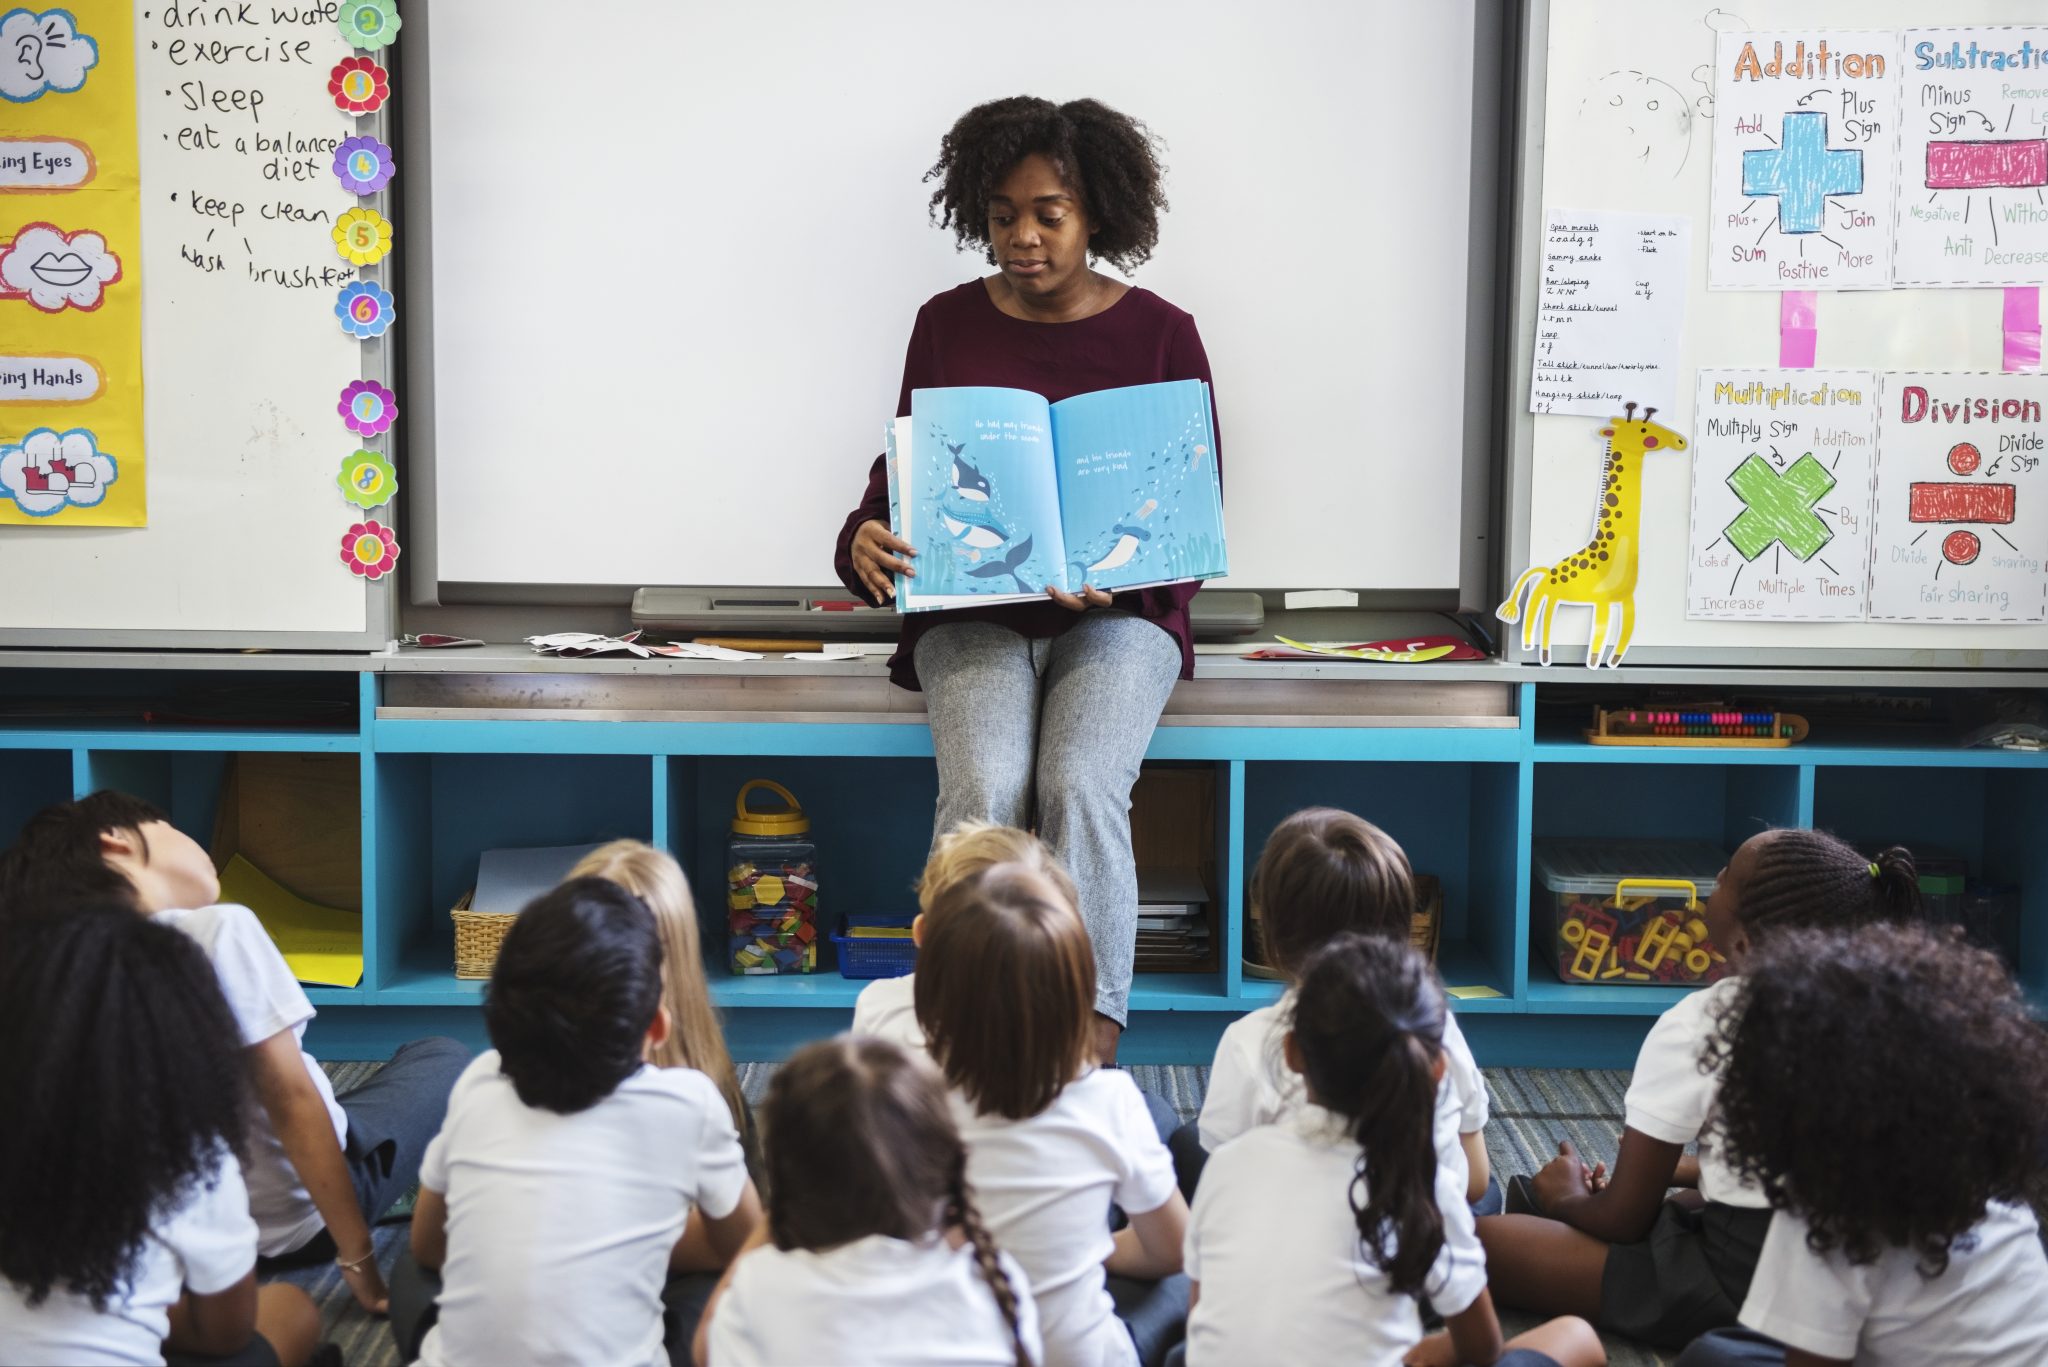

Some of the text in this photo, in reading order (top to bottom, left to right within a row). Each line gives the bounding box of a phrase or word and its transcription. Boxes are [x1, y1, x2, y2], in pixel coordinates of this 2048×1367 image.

[164, 0, 260, 28] drink
[360, 9, 379, 32] 2
[169, 37, 312, 66] exercise
[1733, 40, 1886, 82] Addition
[351, 72, 367, 97] 3
[1921, 83, 1972, 107] Minus
[1841, 88, 1876, 119] Plus
[1734, 113, 1763, 137] Add
[1844, 119, 1881, 143] Sign
[1929, 110, 1967, 135] Sign
[178, 123, 220, 151] eat
[236, 137, 247, 155] a
[0, 151, 72, 175] ing Eyes
[263, 156, 320, 181] diet
[355, 154, 372, 176] 4
[261, 201, 330, 224] clean
[1840, 208, 1876, 231] Join
[1910, 203, 1961, 223] Negative
[355, 226, 370, 248] 5
[1944, 233, 1974, 258] Anti
[1731, 244, 1767, 263] Sum
[1837, 249, 1874, 268] More
[1778, 260, 1830, 281] Positive
[355, 298, 372, 321] 6
[0, 368, 83, 390] ing Hands
[1714, 381, 1862, 410] Multiplication
[1901, 385, 2042, 424] Division
[361, 397, 375, 418] 7
[1707, 417, 1798, 444] Multiply Sign
[1813, 426, 1866, 447] Addition
[1999, 431, 2045, 453] Divide
[2010, 454, 2040, 473] Sign
[357, 467, 377, 490] 8
[1841, 506, 1859, 535] By
[362, 535, 377, 562] 9
[1891, 544, 1928, 565] Divide
[1698, 553, 1731, 568] Lots of
[1758, 577, 1806, 603] Multiple
[1816, 577, 1856, 597] Times
[1920, 583, 1945, 604] Fair
[1700, 596, 1765, 611] Increase
